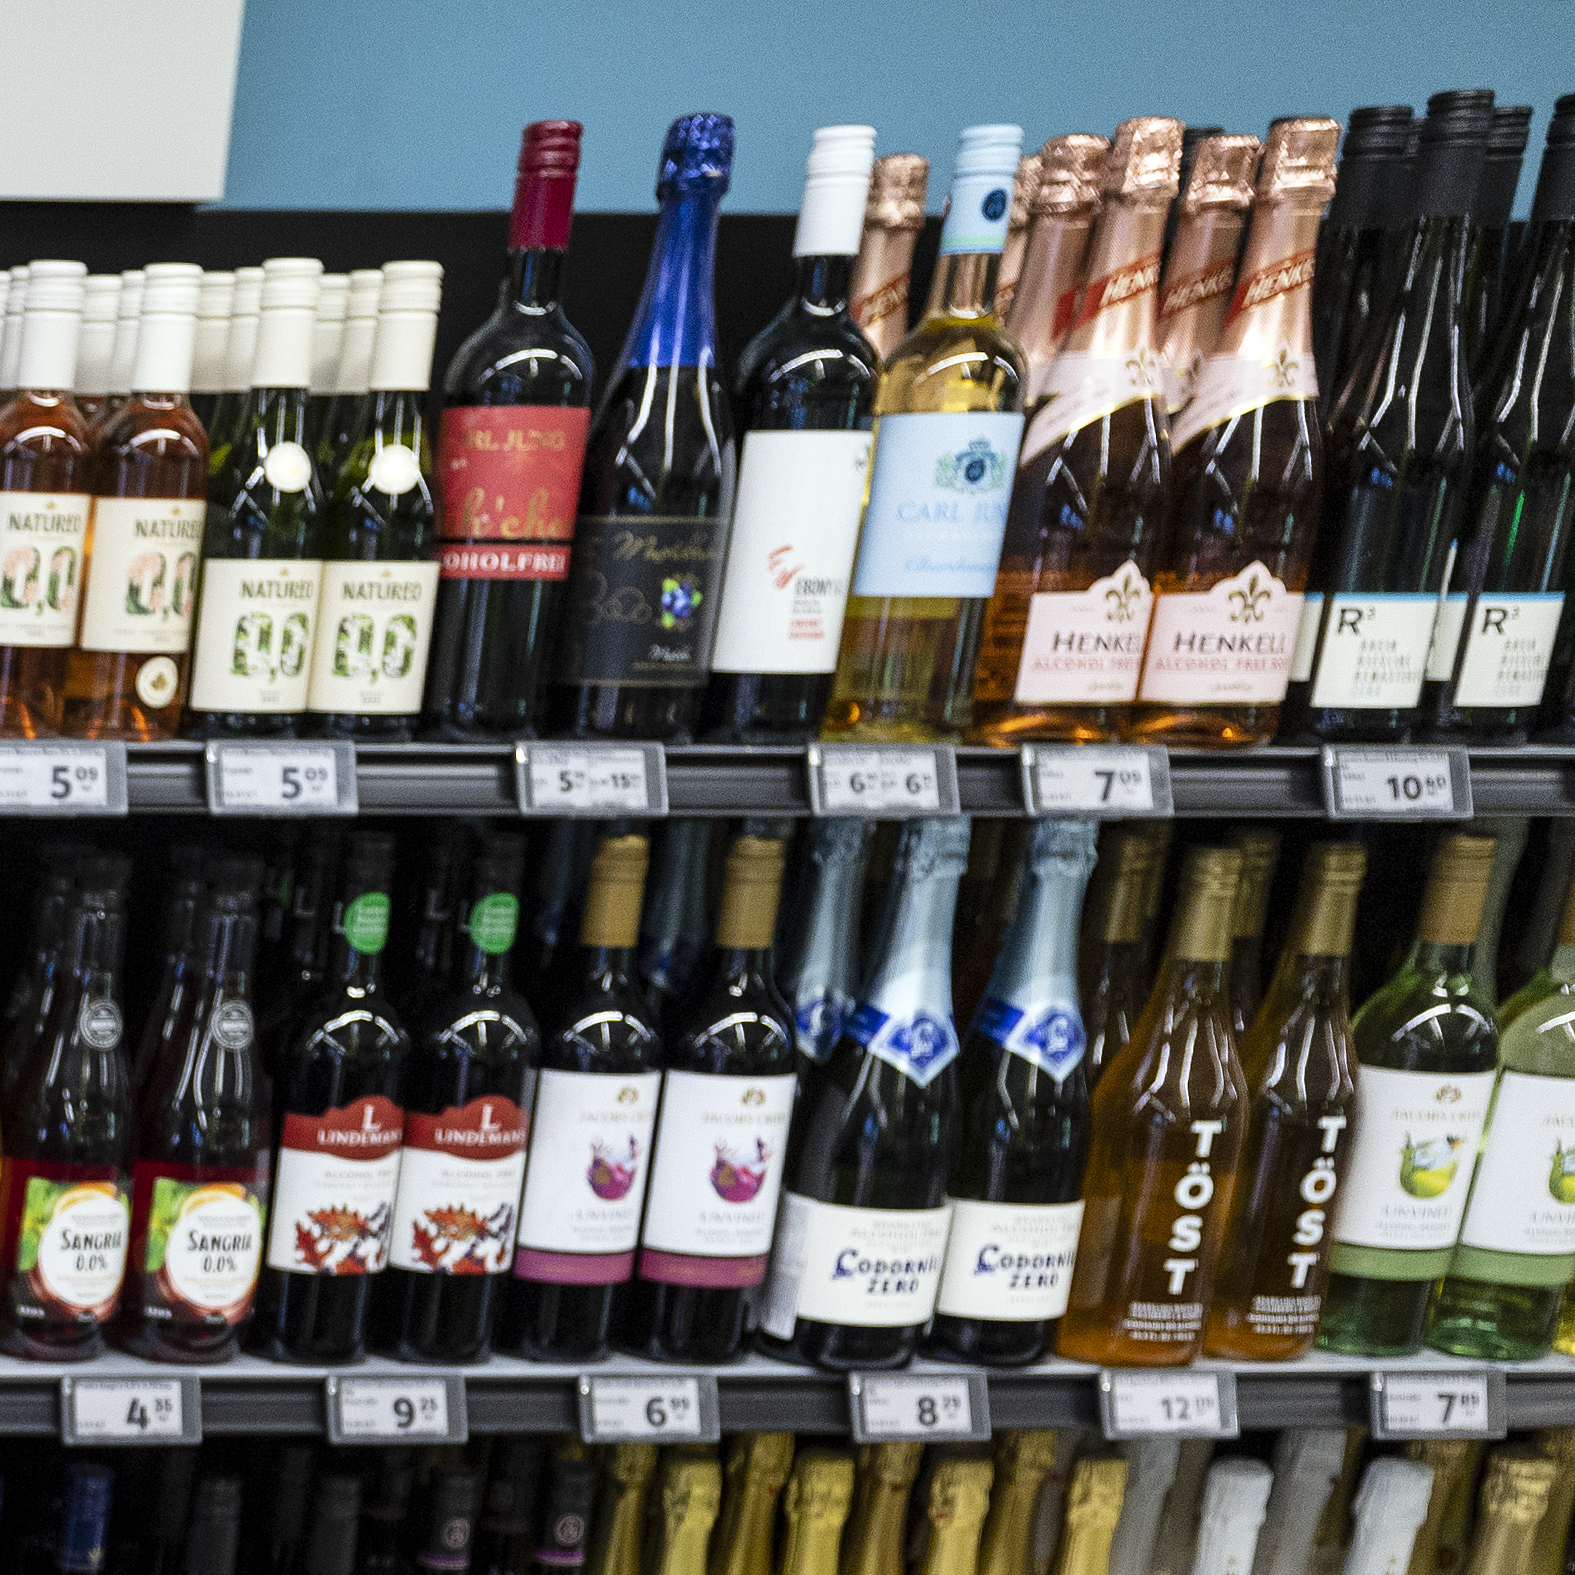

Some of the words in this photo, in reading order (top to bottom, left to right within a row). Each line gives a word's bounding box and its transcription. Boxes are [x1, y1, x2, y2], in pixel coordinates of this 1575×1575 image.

[342, 581, 421, 601] NATUREO
[50, 767, 72, 799] 5
[280, 767, 302, 800] 5
[1095, 771, 1116, 802] 7
[1388, 776, 1421, 800] 10
[127, 1398, 149, 1430] 4
[393, 1397, 415, 1428] 9
[645, 1397, 668, 1427] 6
[916, 1397, 938, 1426] 8
[1162, 1396, 1191, 1421] 12
[1438, 1393, 1458, 1423] 7
